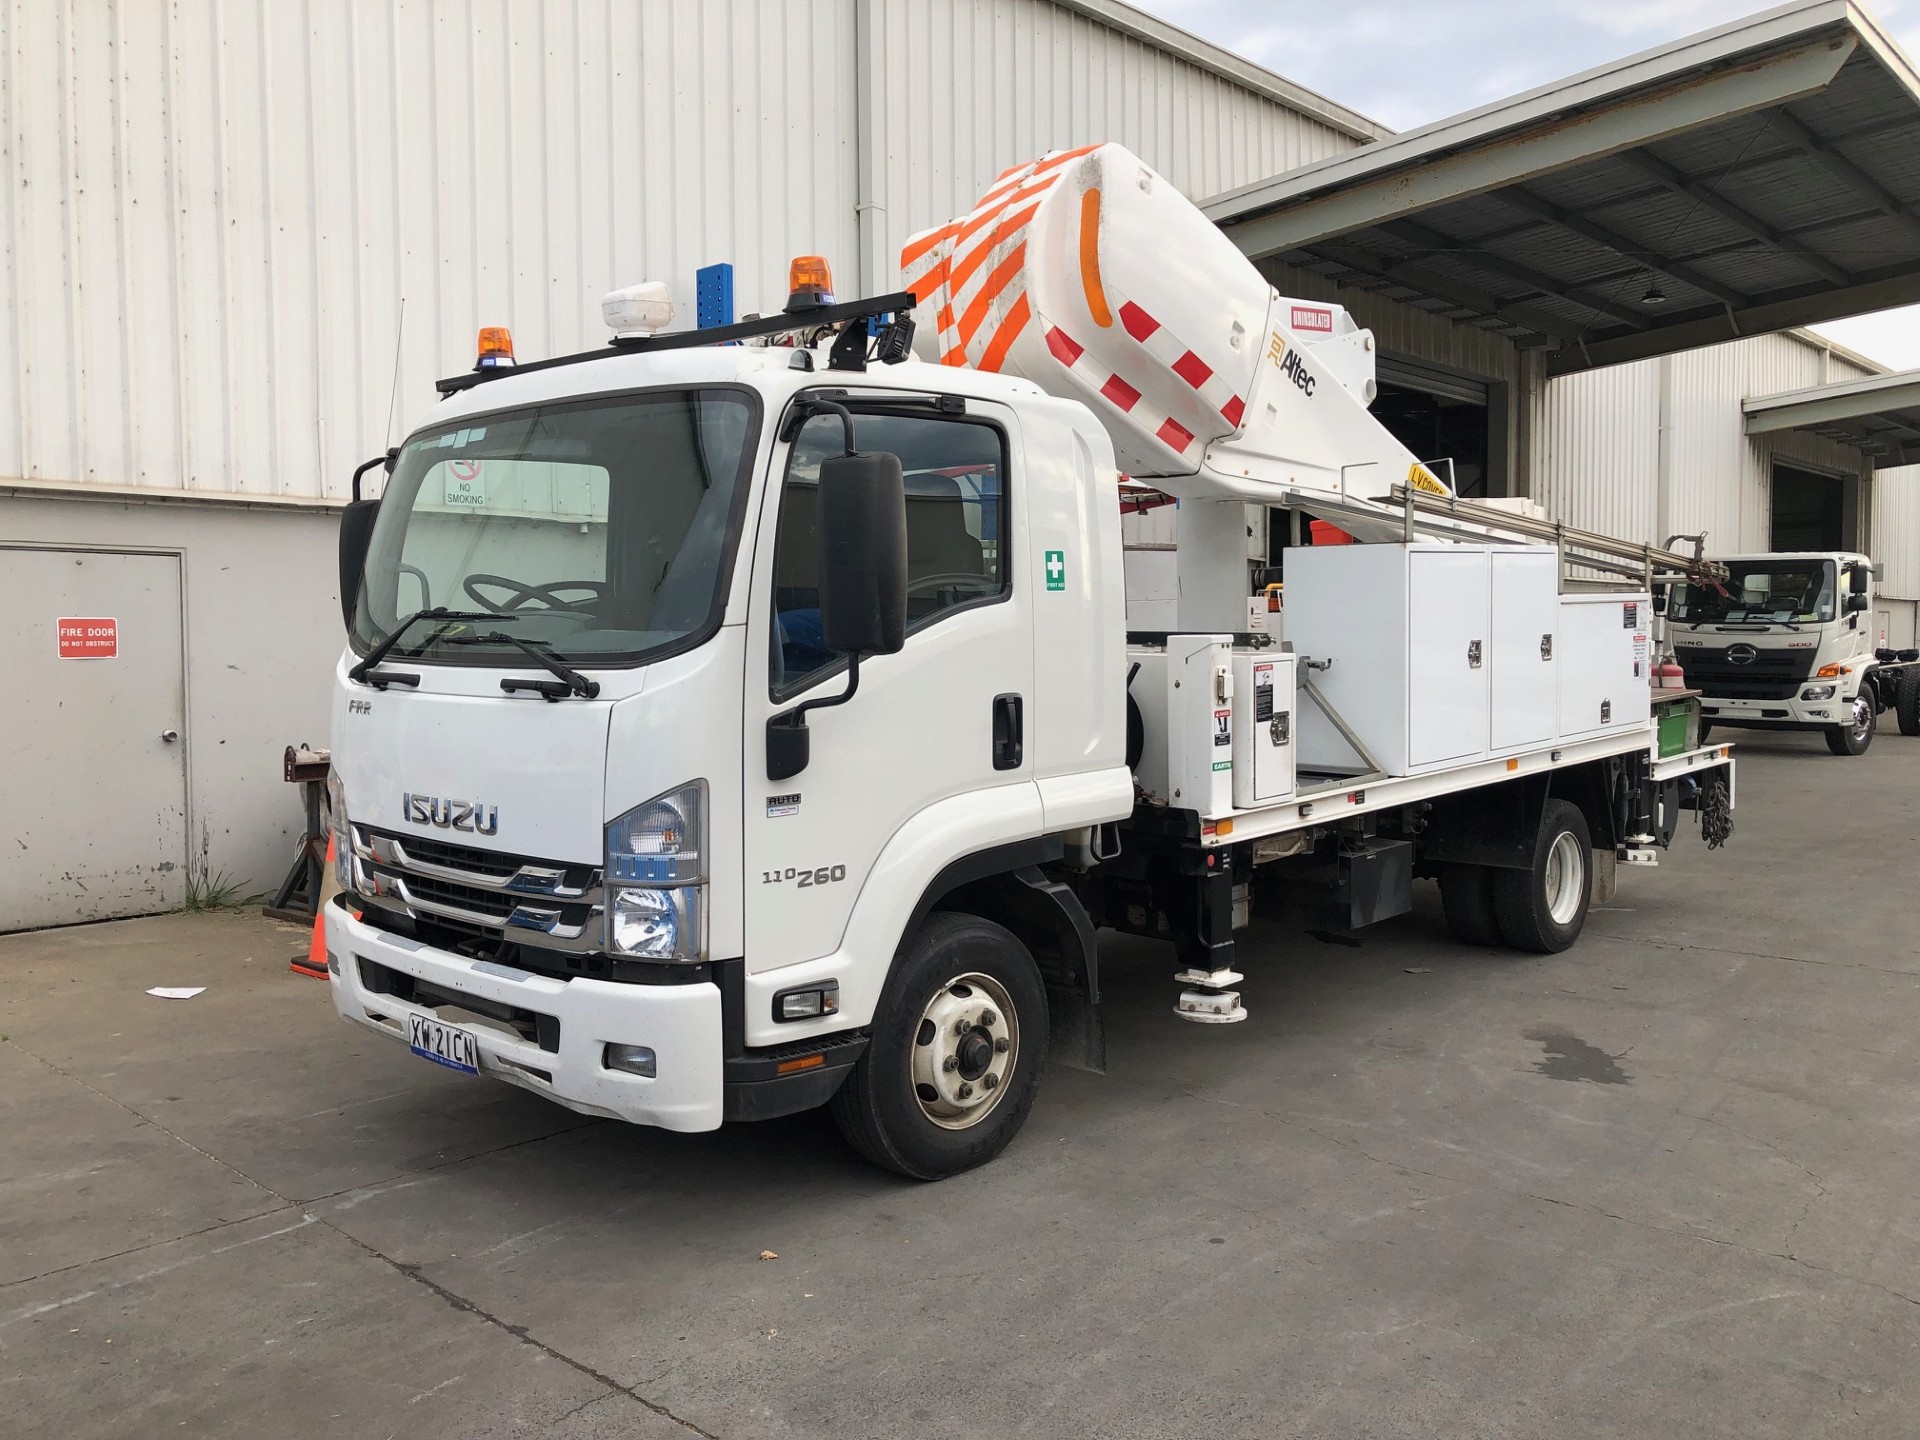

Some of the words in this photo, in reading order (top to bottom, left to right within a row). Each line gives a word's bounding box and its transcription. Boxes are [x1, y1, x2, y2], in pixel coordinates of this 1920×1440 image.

[1293, 310, 1330, 328] UNINSULATED
[1280, 348, 1316, 398] Altec
[459, 483, 471, 492] NO
[447, 493, 484, 505] SMOKING
[60, 627, 83, 637] FIRE
[87, 627, 115, 637] DOOR
[349, 699, 371, 715] FRR
[1213, 762, 1231, 770] EARTH
[768, 794, 799, 806] AUTO
[403, 792, 498, 836] ISUZU
[797, 864, 846, 888] 260
